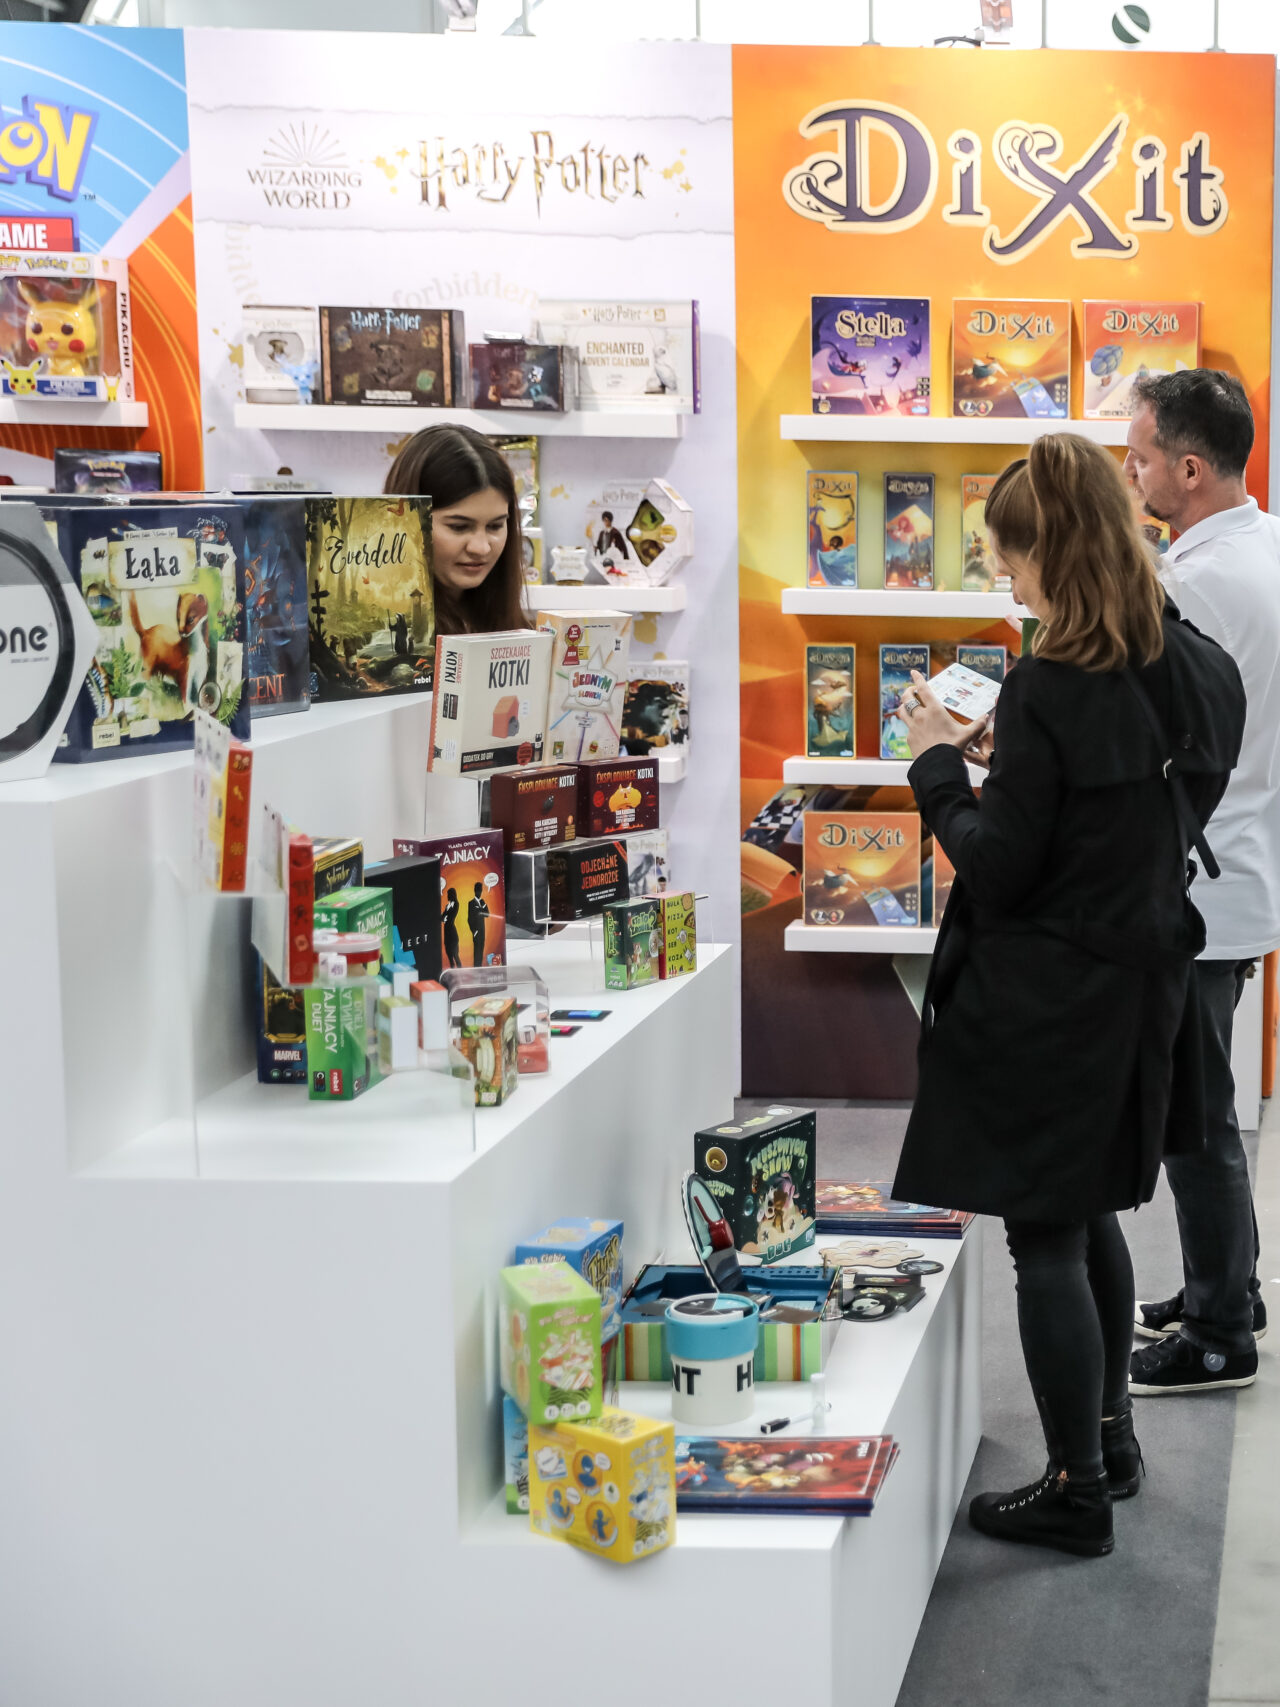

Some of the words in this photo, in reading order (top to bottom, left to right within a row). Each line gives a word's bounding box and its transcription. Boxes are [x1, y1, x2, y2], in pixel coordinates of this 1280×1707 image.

[0, 99, 97, 200] ON
[247, 168, 362, 190] WIZARDING
[410, 136, 525, 213] Harry
[530, 131, 649, 219] Potter
[263, 189, 351, 210] WORLD
[120, 292, 131, 368] PIKACHU
[835, 309, 907, 339] Stella
[586, 342, 645, 356] ENCHANTED
[581, 357, 610, 367] ADVENT
[612, 357, 650, 367] CALENDAR
[325, 532, 407, 574] Everdell
[125, 547, 181, 582] Łąka
[444, 650, 458, 684] KOTKI
[488, 659, 530, 689] KOTKI
[414, 676, 432, 685] rebel
[572, 671, 613, 693] JEDNYM
[98, 731, 115, 740] rebel
[559, 775, 576, 788] KOTKI
[637, 768, 654, 779] KOTKI
[667, 913, 684, 921] PIZZA
[668, 954, 683, 962] KOZA
[311, 1002, 322, 1033] DUET
[274, 1050, 301, 1061] MARVEL
[332, 1071, 340, 1092] rebel
[736, 1357, 755, 1393] H
